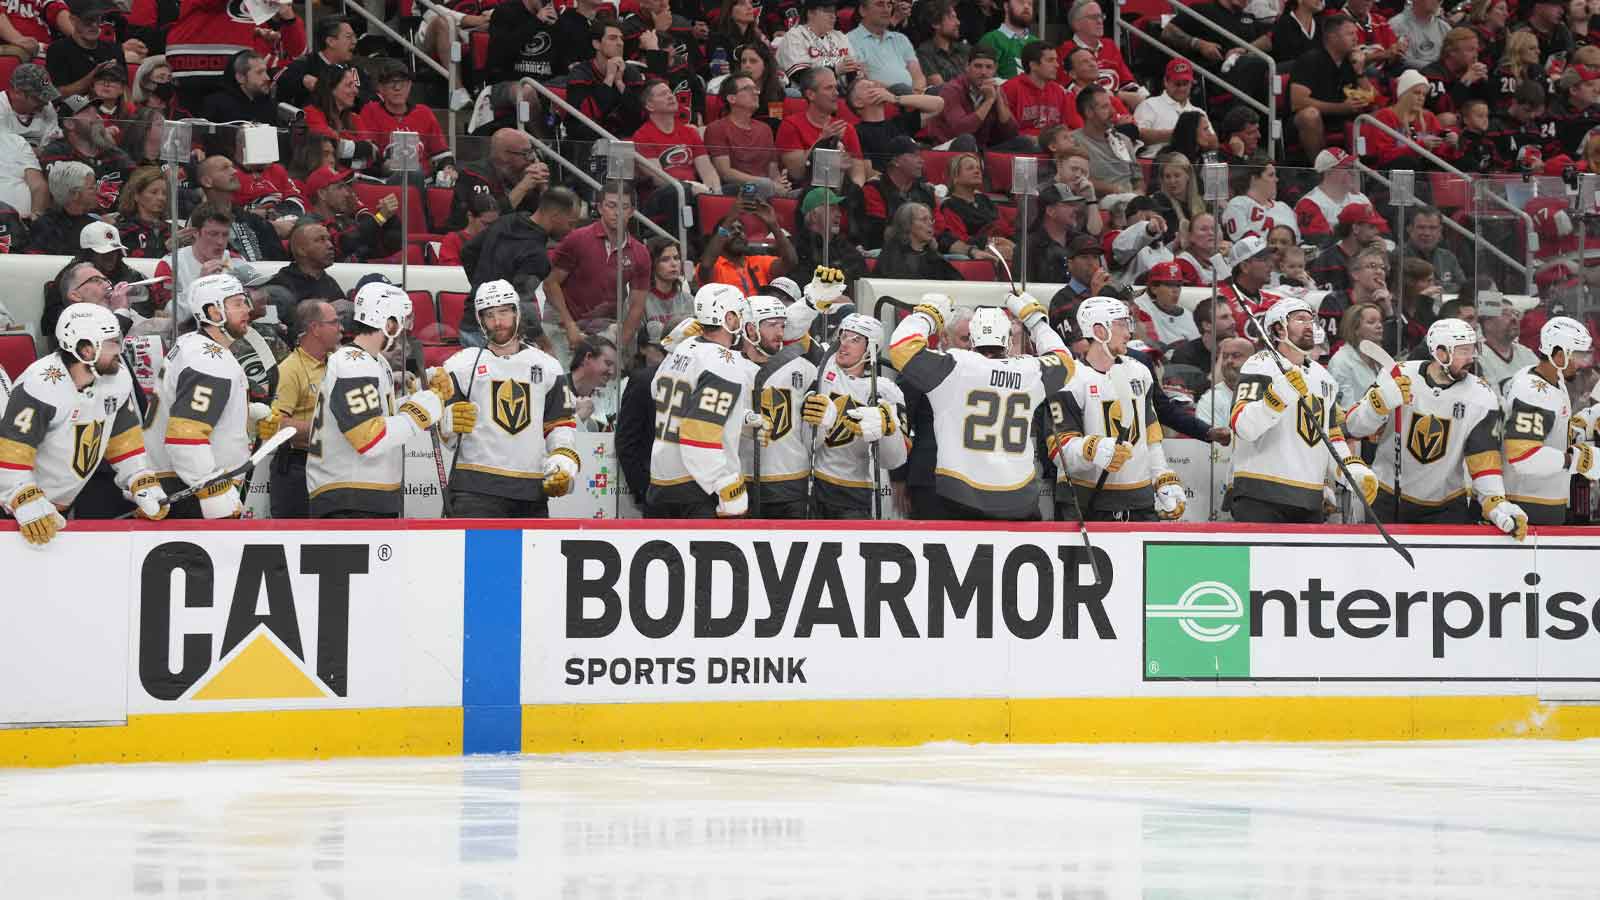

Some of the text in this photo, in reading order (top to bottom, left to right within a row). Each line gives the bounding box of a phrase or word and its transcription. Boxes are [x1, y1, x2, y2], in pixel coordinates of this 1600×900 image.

[1430, 81, 1446, 97] 24
[1501, 77, 1516, 93] 20
[1541, 122, 1556, 138] 24
[982, 326, 993, 335] 26
[1057, 319, 1073, 338] 74
[990, 369, 1022, 390] DOWD
[190, 385, 215, 412] 5
[345, 383, 380, 415] 52
[699, 386, 734, 417] 22
[14, 406, 36, 434] 4
[963, 390, 1031, 454] 26
[403, 483, 438, 497] aleigh
[561, 540, 1118, 640] BODYARMOR
[139, 541, 369, 701] CAT
[565, 657, 807, 686] SPORTS DRINK
